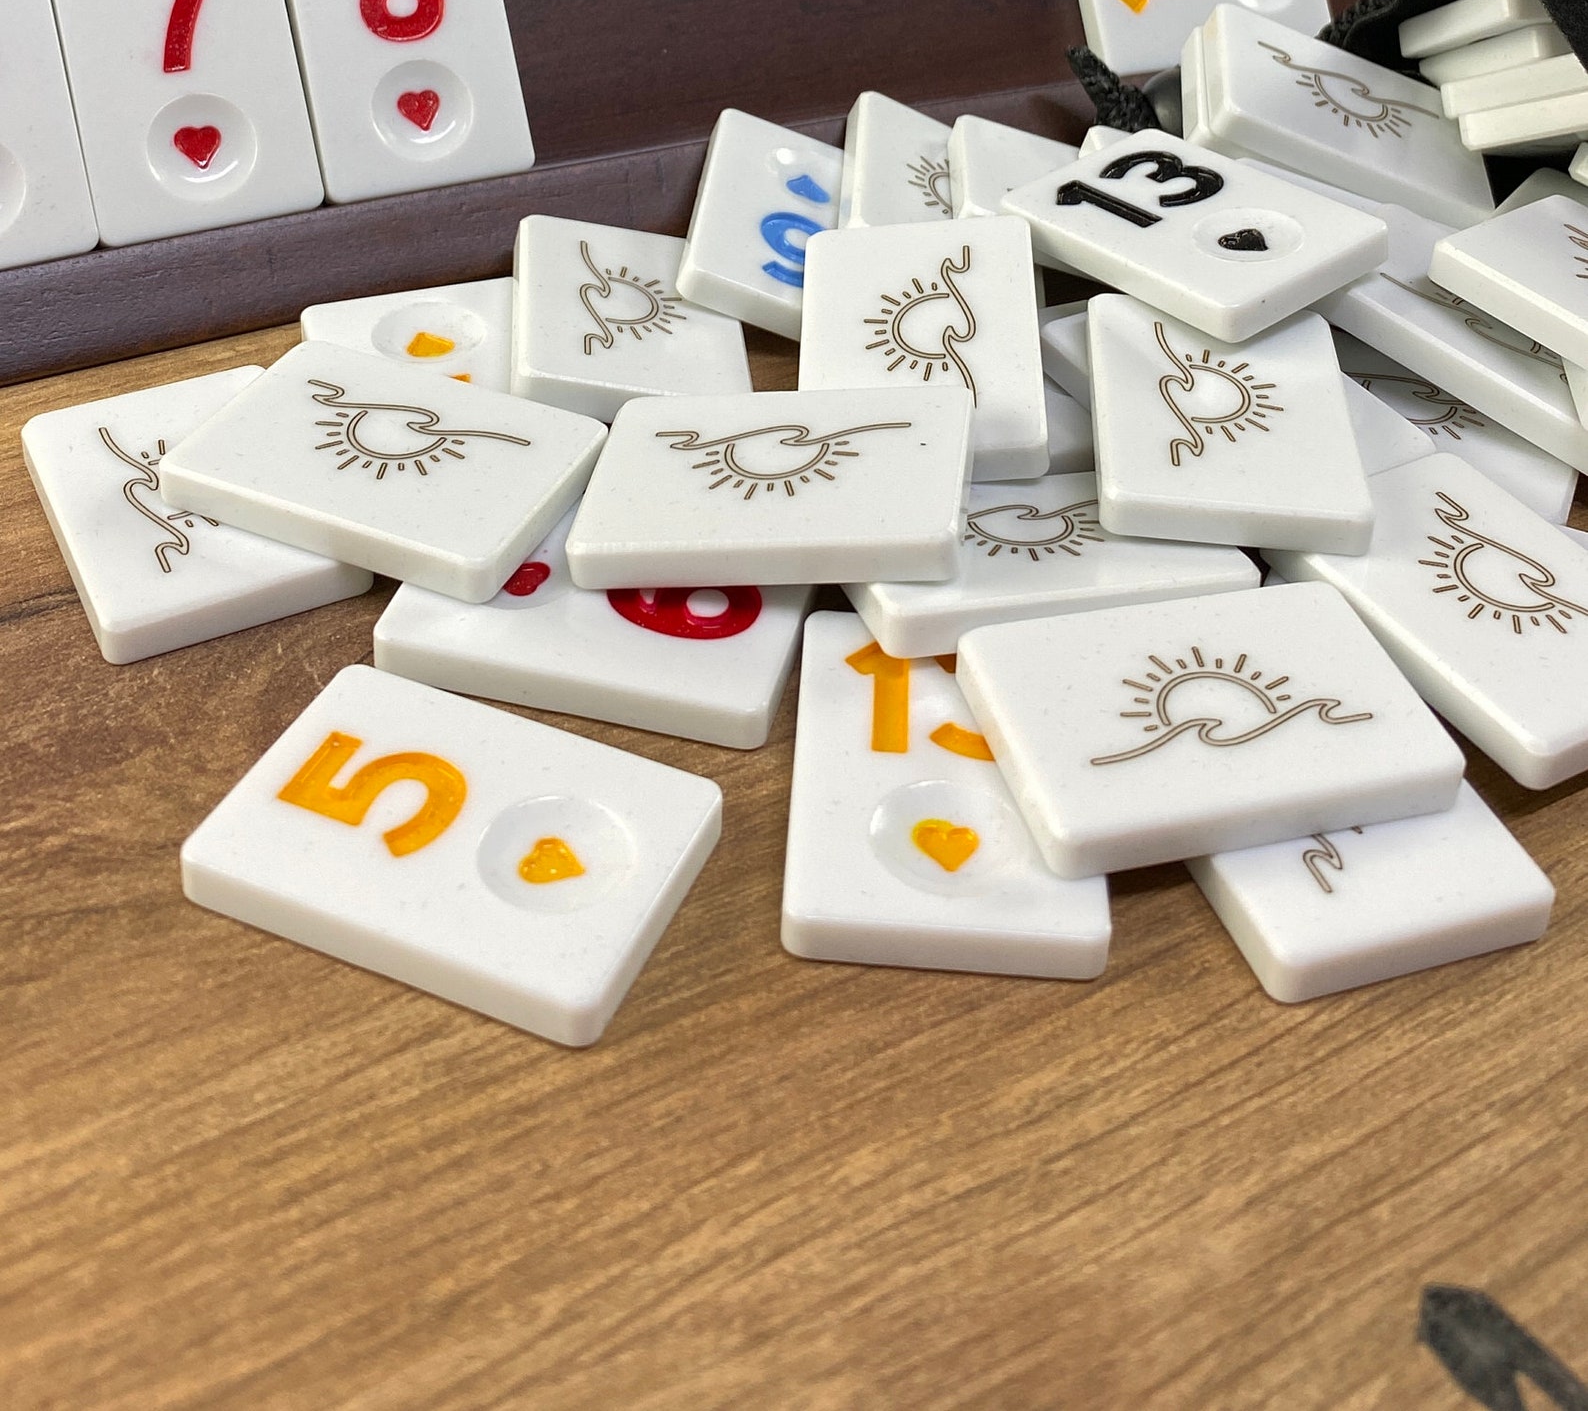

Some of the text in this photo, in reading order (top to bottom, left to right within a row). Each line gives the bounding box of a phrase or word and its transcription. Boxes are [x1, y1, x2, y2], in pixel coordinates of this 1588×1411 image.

[1055, 149, 1226, 230] 13
[844, 639, 997, 763] 1
[274, 728, 471, 859] 5
